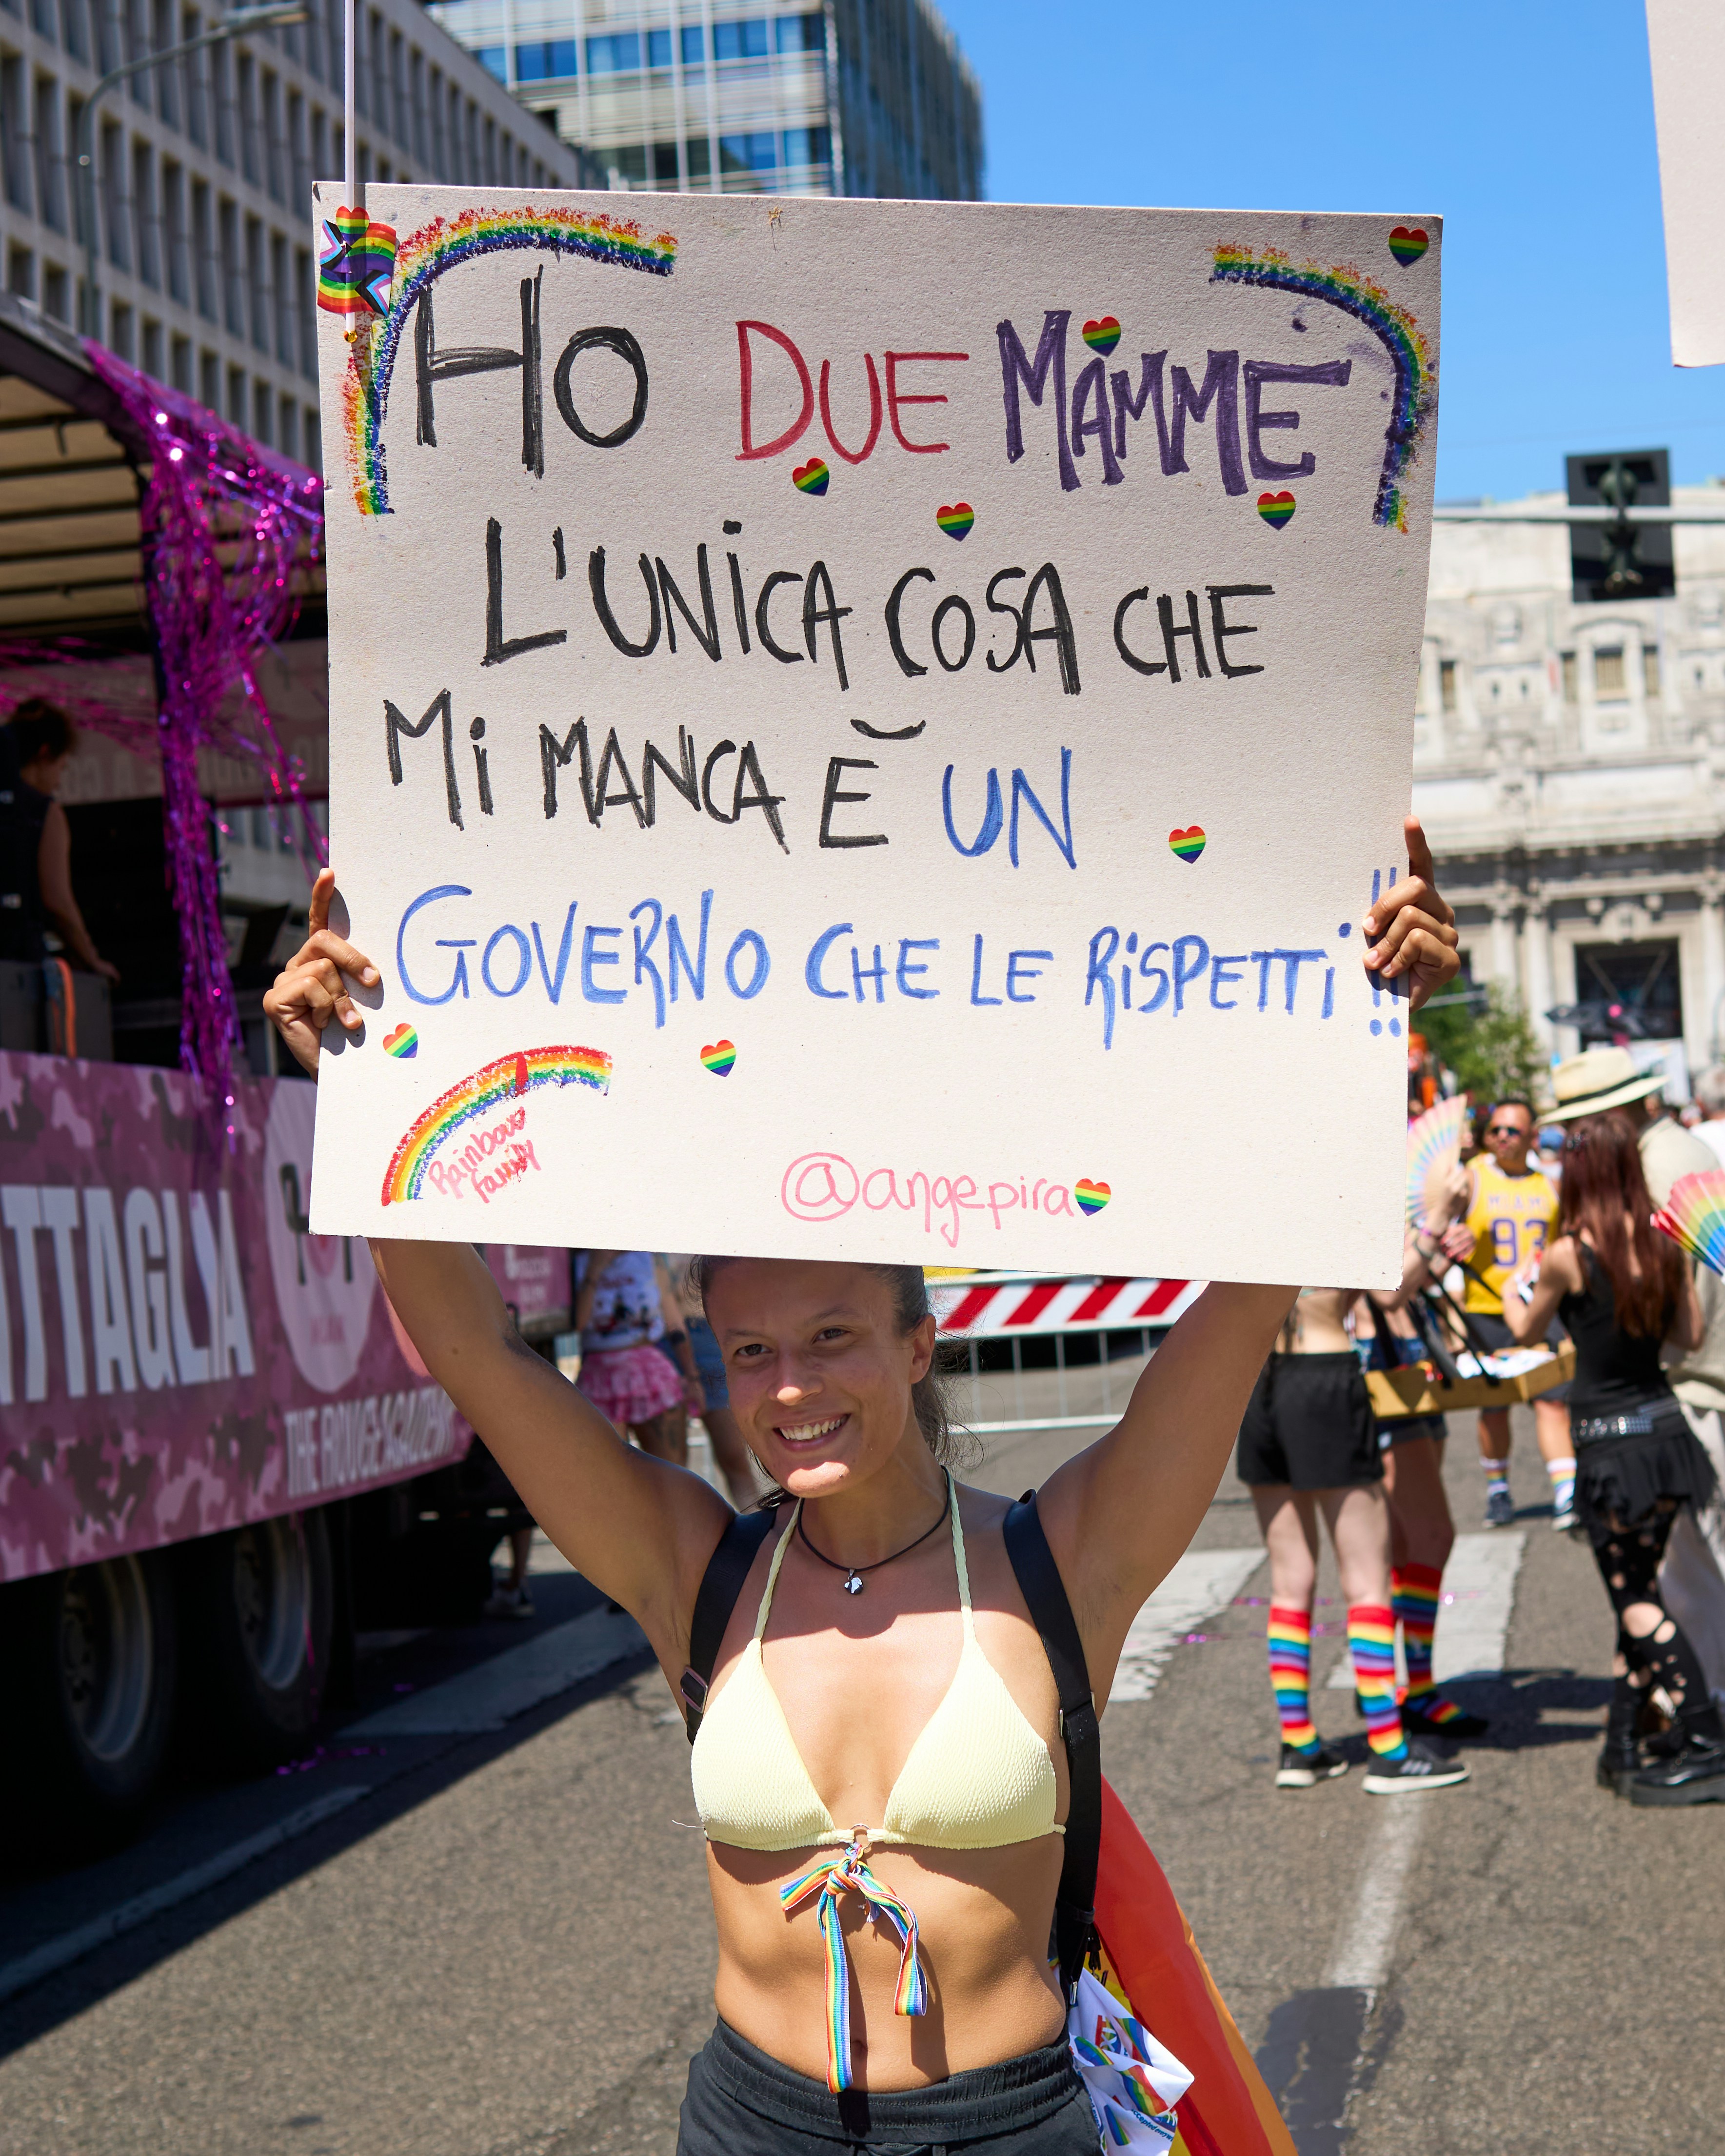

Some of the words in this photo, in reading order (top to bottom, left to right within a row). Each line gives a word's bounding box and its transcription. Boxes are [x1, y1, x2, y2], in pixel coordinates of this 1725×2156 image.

[415, 264, 649, 480] HO
[734, 320, 970, 465] DUE
[995, 309, 1352, 497] MAMME
[884, 562, 1082, 696] COSA
[1113, 584, 1276, 684] CHE
[538, 715, 791, 855] MANCA
[942, 746, 1077, 870] UN
[396, 884, 771, 1029] GOVERNO
[805, 923, 940, 1003] CHE
[970, 933, 1054, 1007] LE
[781, 1152, 1074, 1248] @angepira
